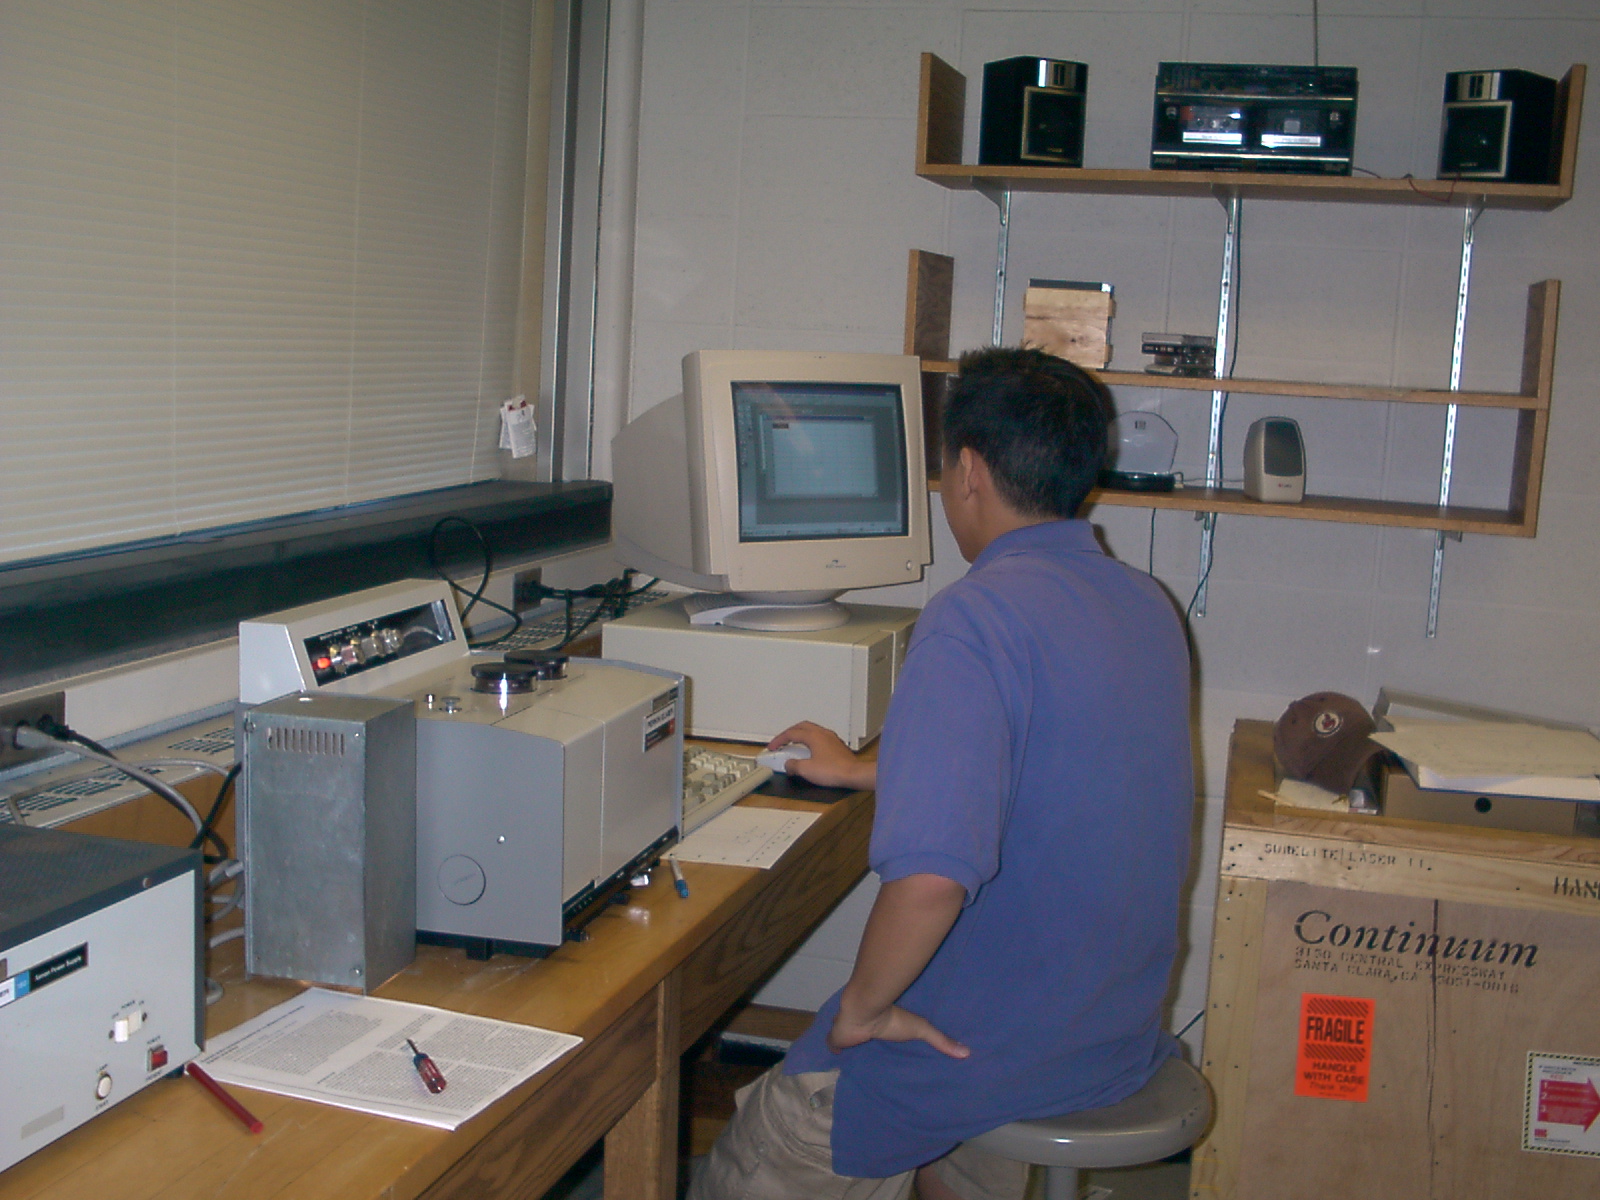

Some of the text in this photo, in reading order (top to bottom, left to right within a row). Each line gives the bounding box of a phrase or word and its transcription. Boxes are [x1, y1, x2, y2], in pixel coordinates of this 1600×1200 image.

[1348, 851, 1396, 865] LASER
[1294, 909, 1538, 968] Continuum
[1295, 958, 1338, 973] SANTA
[1341, 951, 1404, 968] CENTRAL
[1305, 1015, 1365, 1045] FRAGILE
[1312, 1061, 1357, 1074] HANDLE
[1303, 1071, 1365, 1085] WITH CARE
